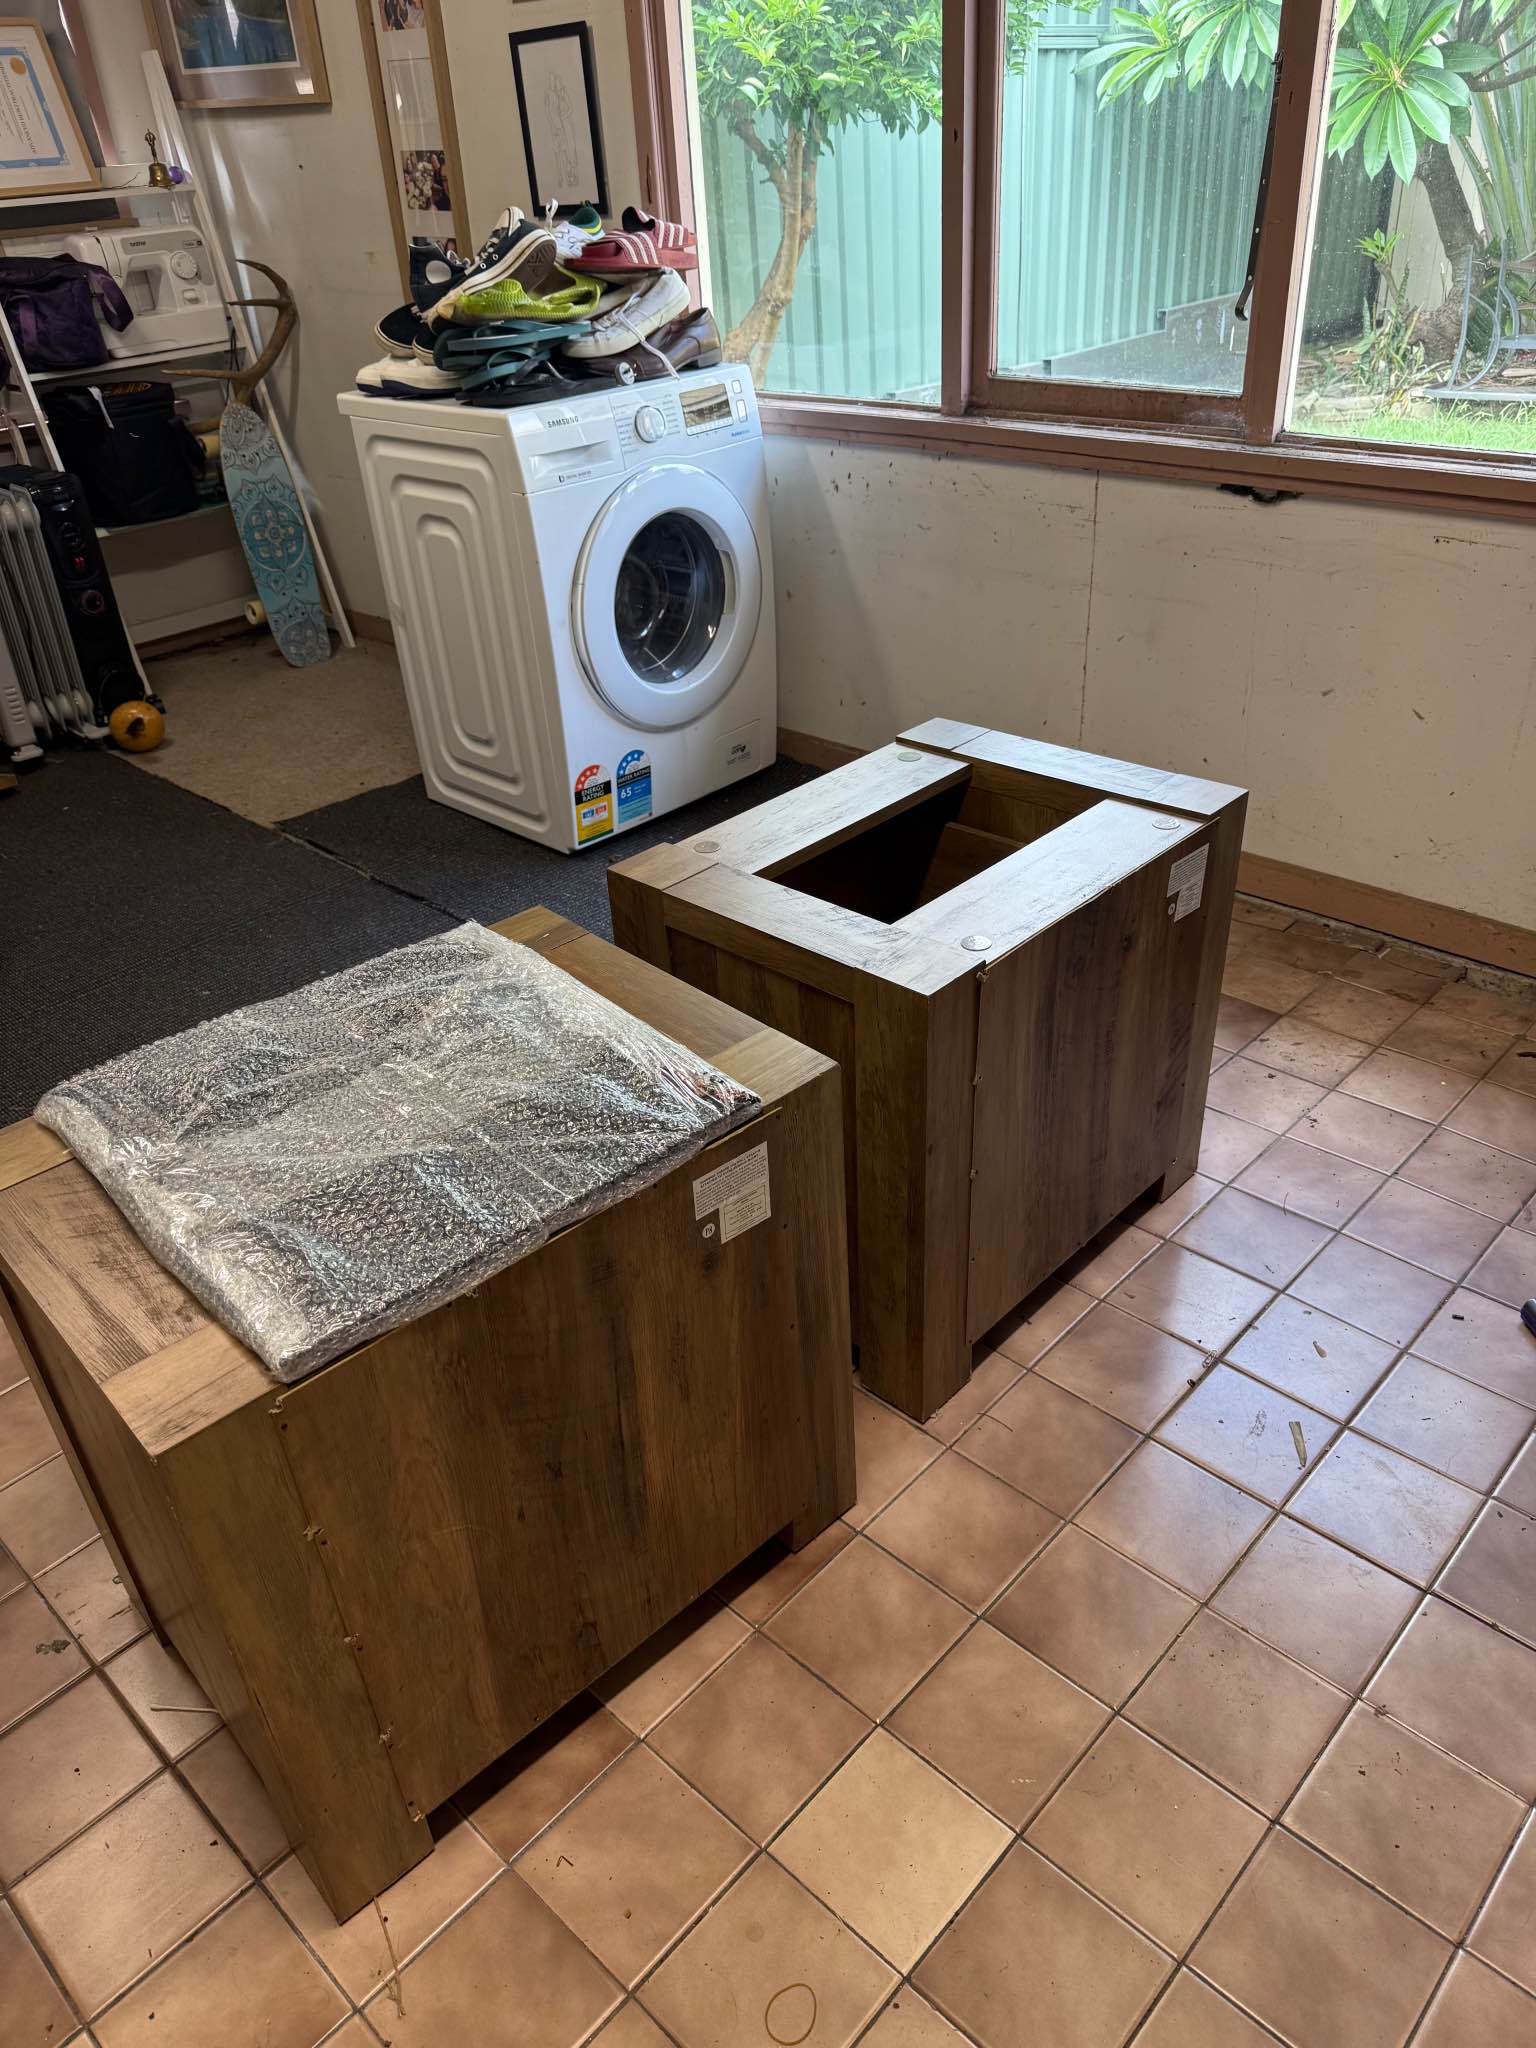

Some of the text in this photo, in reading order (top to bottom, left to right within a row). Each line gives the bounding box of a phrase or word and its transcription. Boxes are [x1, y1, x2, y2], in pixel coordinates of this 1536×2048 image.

[547, 415, 579, 428] SAMSUNG
[581, 783, 605, 796] ENERGY
[620, 787, 632, 799] 65
[582, 790, 605, 802] RATING
